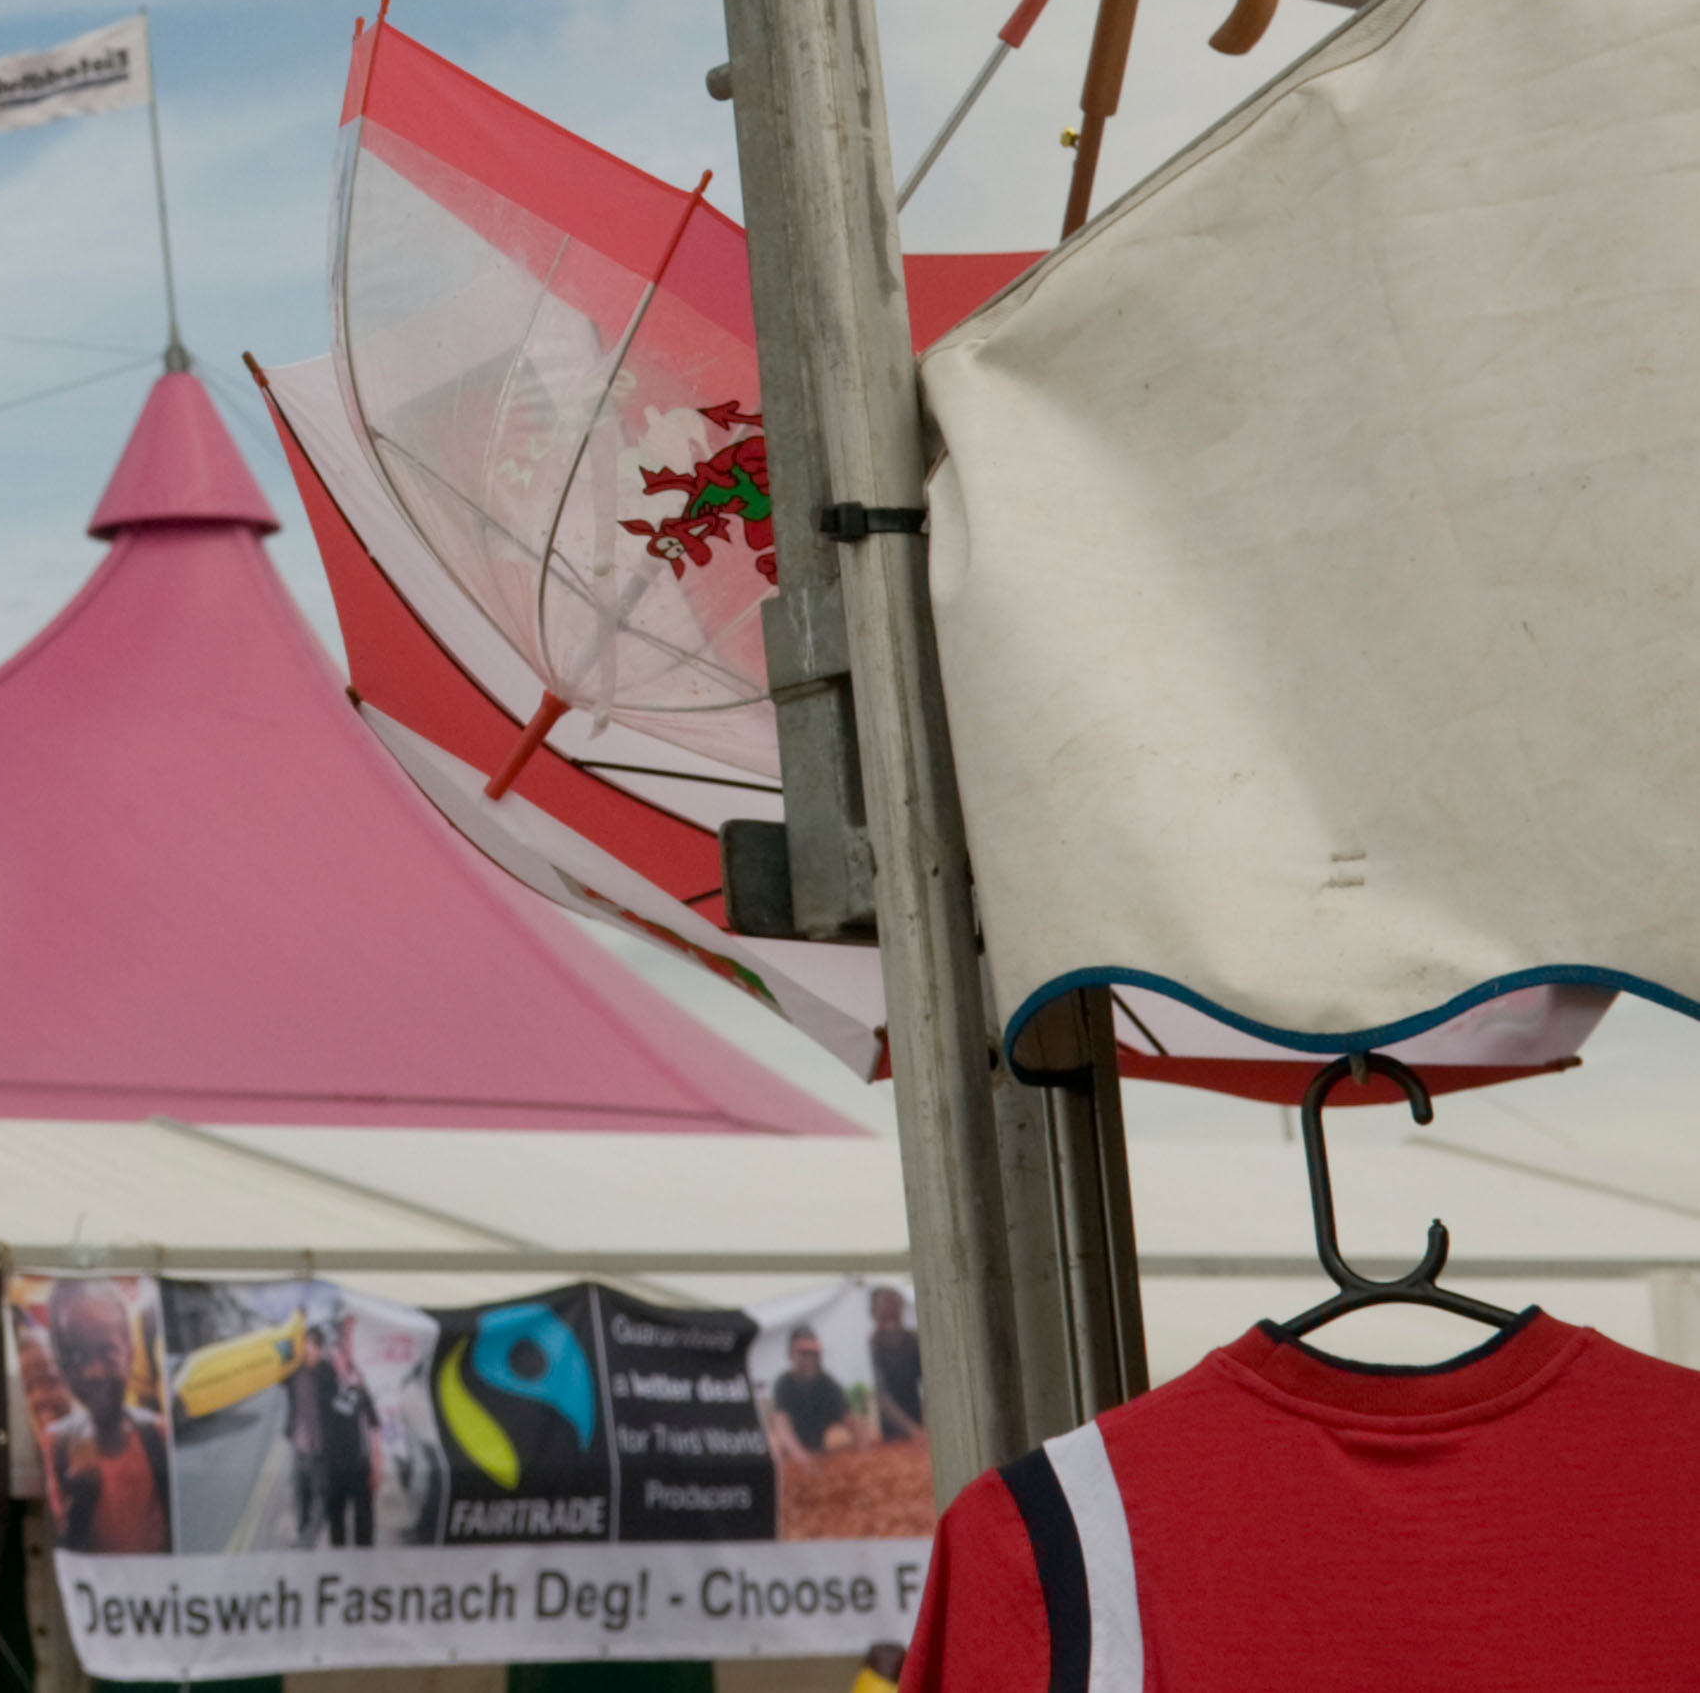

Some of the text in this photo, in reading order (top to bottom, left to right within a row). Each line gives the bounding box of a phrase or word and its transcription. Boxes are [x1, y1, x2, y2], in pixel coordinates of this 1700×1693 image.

[644, 1478, 752, 1511] Producers
[448, 1496, 606, 1537] FAIRTRADE
[314, 1570, 519, 1629] Fasnach
[533, 1563, 653, 1637] Deg!
[697, 1563, 879, 1623] Choose
